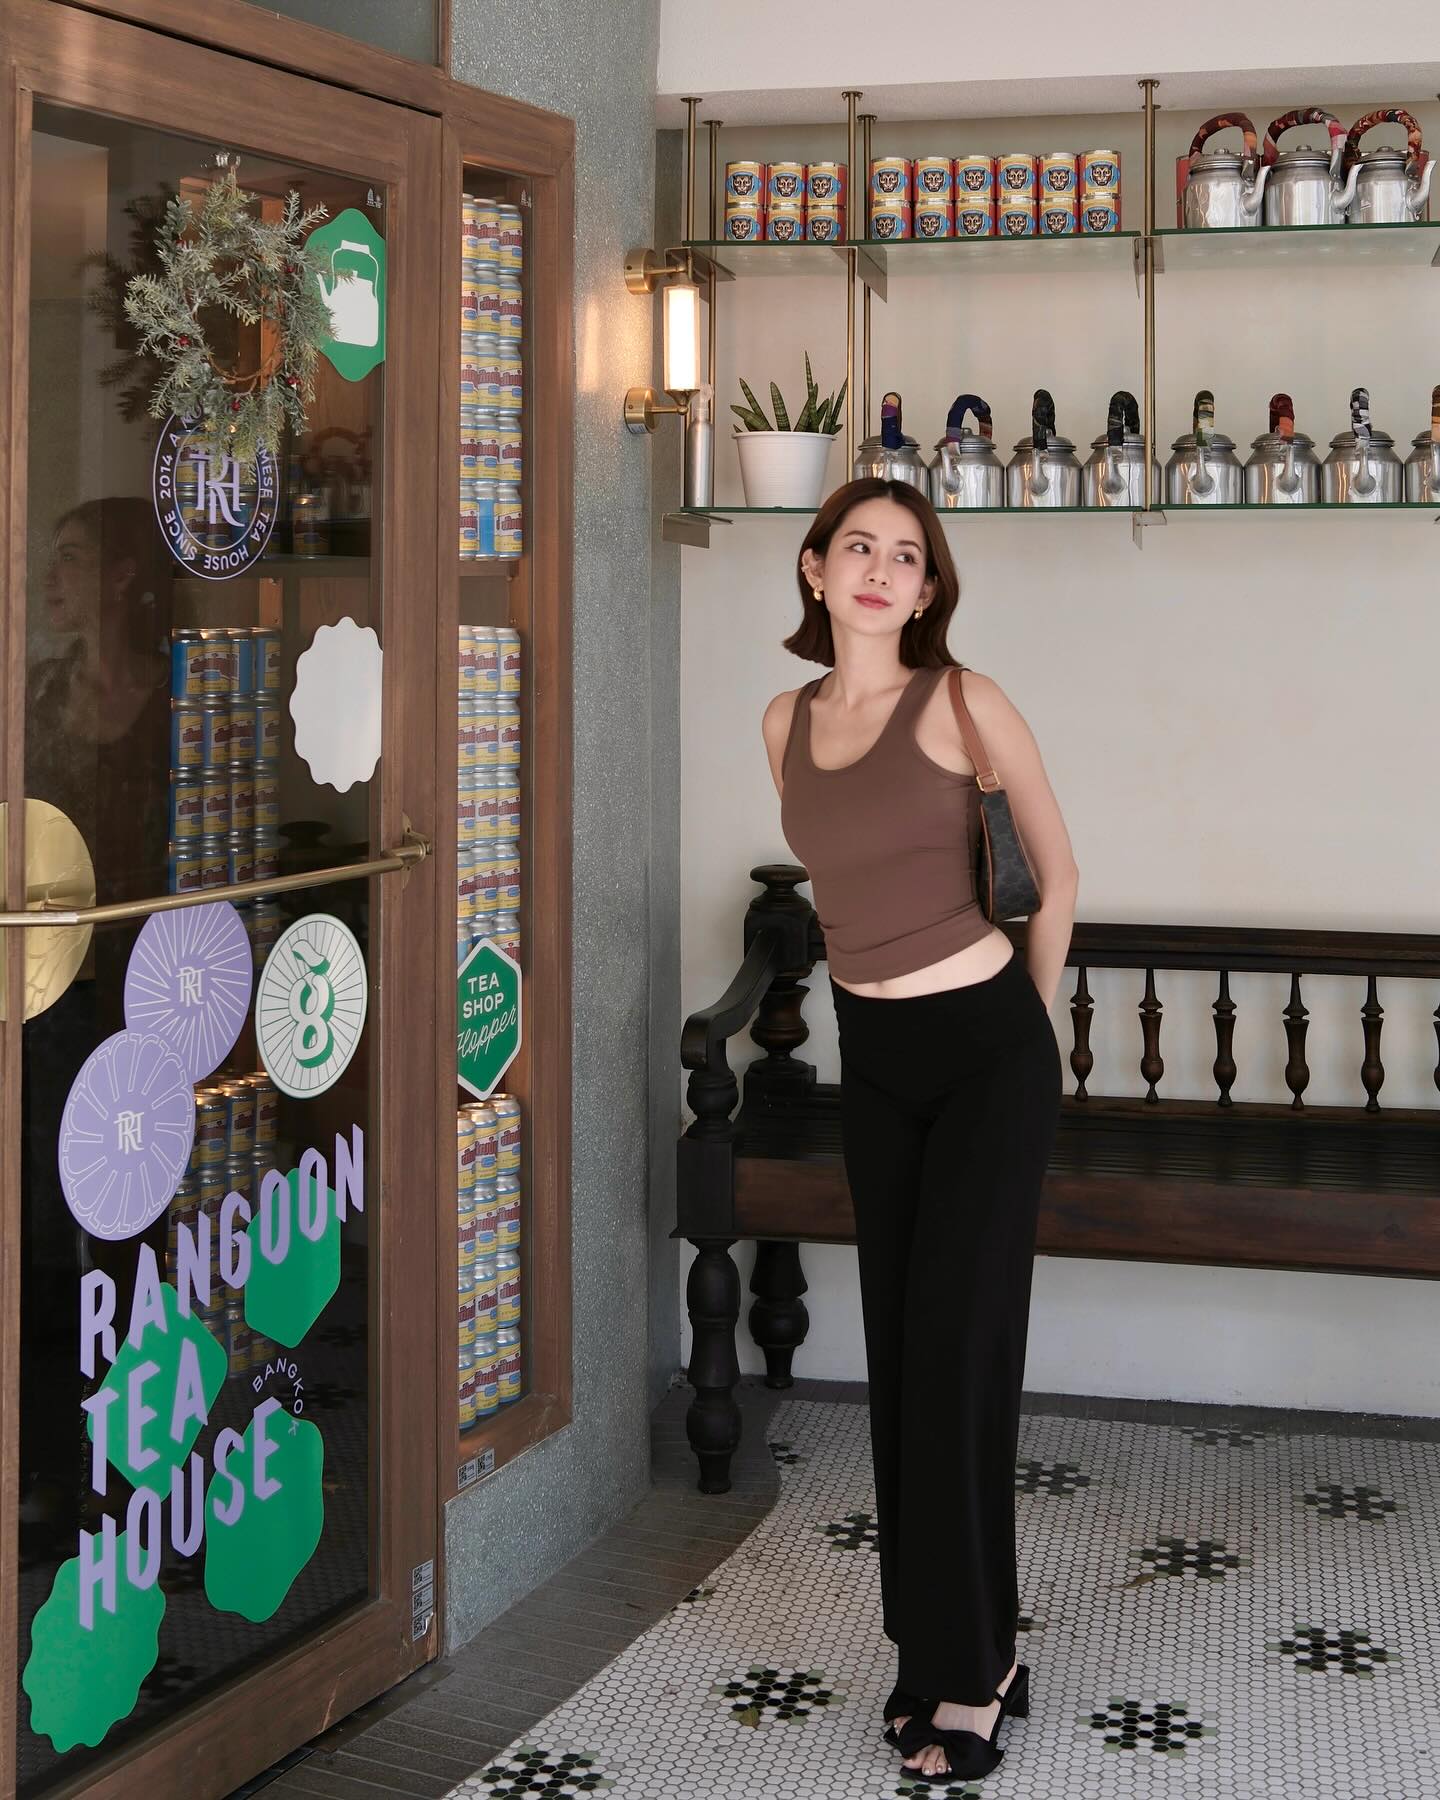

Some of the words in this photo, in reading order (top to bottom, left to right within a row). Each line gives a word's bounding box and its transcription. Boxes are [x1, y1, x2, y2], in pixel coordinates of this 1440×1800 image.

[169, 433, 181, 448] A
[159, 454, 174, 499] 2014
[164, 510, 198, 561] SINCE
[250, 511, 271, 542] TEA
[203, 544, 249, 571] HOUSE
[462, 992, 505, 1019] SHOP
[467, 972, 500, 994] TEA
[458, 1004, 517, 1062] Hopper
[80, 1124, 364, 1379] RANGOON
[80, 1339, 208, 1497] TEA
[252, 1357, 305, 1437] BANGKOK
[79, 1396, 283, 1631] HOUSE
